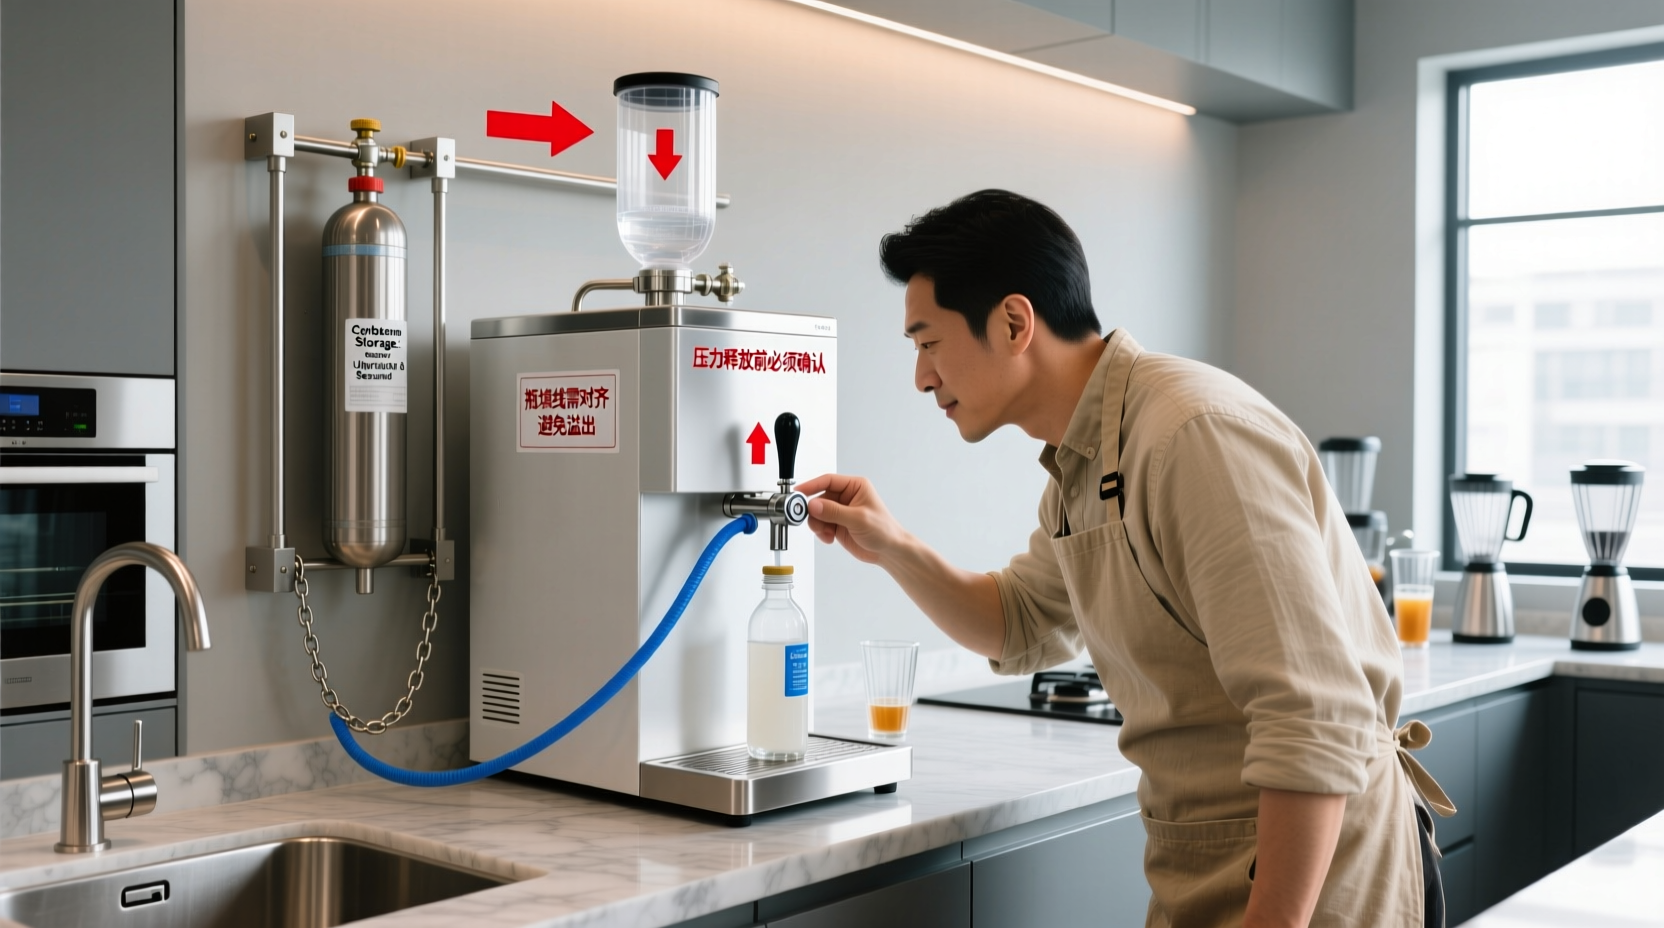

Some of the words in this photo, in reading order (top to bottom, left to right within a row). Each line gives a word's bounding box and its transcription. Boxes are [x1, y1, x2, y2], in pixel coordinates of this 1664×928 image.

[693, 346, 826, 374] 压力释放前必须确认
[538, 414, 596, 436] 避免溢出
